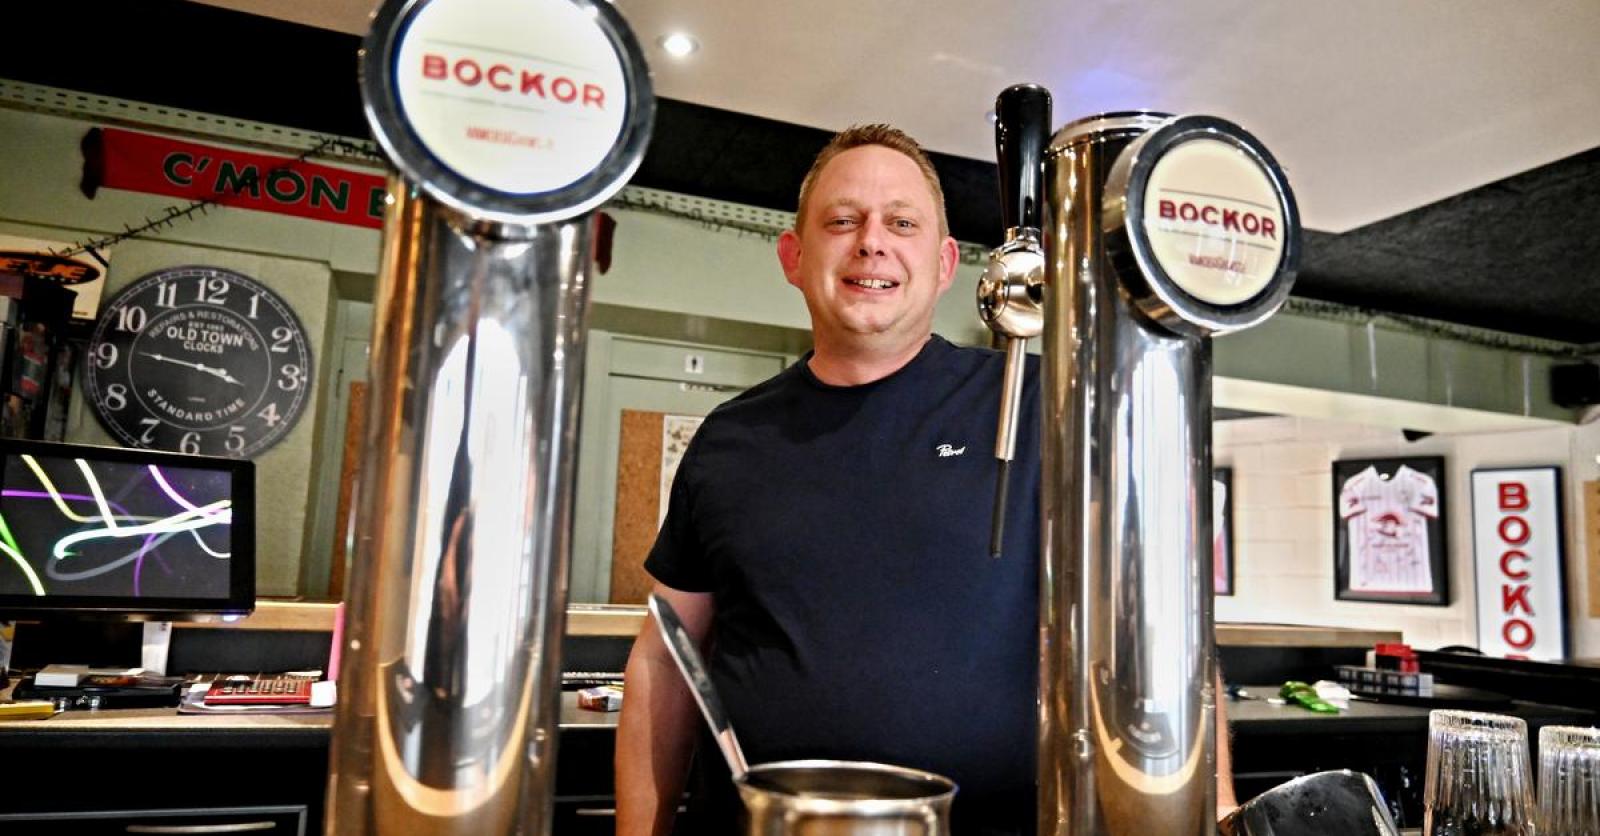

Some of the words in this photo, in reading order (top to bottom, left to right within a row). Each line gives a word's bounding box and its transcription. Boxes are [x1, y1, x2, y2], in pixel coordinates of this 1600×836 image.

[422, 54, 606, 109] BOCKOR
[163, 152, 349, 212] C'MON
[1158, 199, 1277, 241] BOCKOR
[156, 281, 178, 308] 11
[196, 276, 230, 305] 12
[116, 305, 147, 333] 10
[248, 293, 259, 319] 1
[167, 326, 197, 342] OLD
[201, 330, 244, 348] TOWN
[183, 340, 224, 354] CLOCKS
[271, 326, 293, 353] 2
[95, 342, 119, 369] 9
[277, 364, 301, 391] 3
[104, 383, 127, 411] 8
[147, 388, 214, 422] STANDARD
[216, 397, 245, 419] TIME
[257, 402, 281, 427] 4
[138, 418, 161, 443] 7
[179, 431, 202, 455] 6
[223, 425, 247, 451] 5
[1496, 482, 1536, 661] BOCKO
